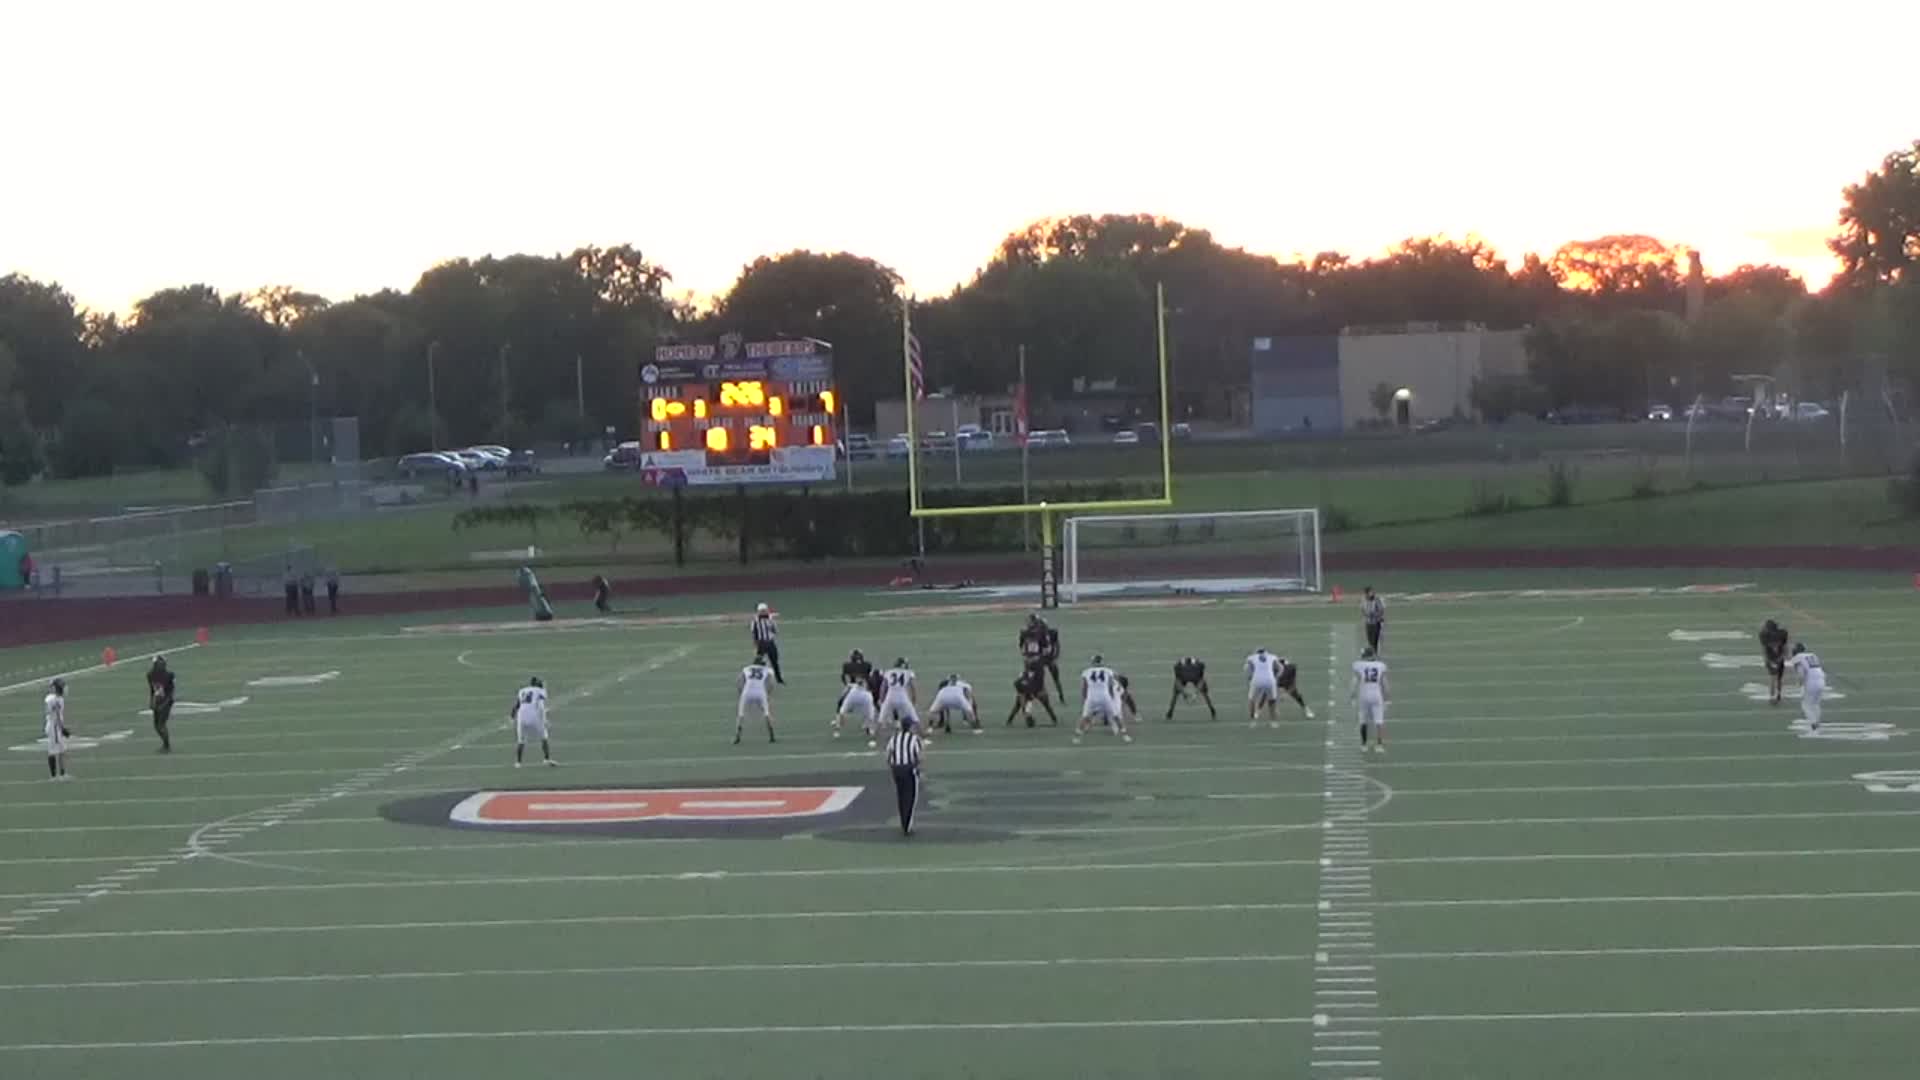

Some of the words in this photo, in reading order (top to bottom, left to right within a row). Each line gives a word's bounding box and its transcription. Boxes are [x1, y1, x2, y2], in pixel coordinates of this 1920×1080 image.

[890, 672, 905, 686] 34
[1090, 671, 1105, 683] 44
[1364, 667, 1378, 682] 12
